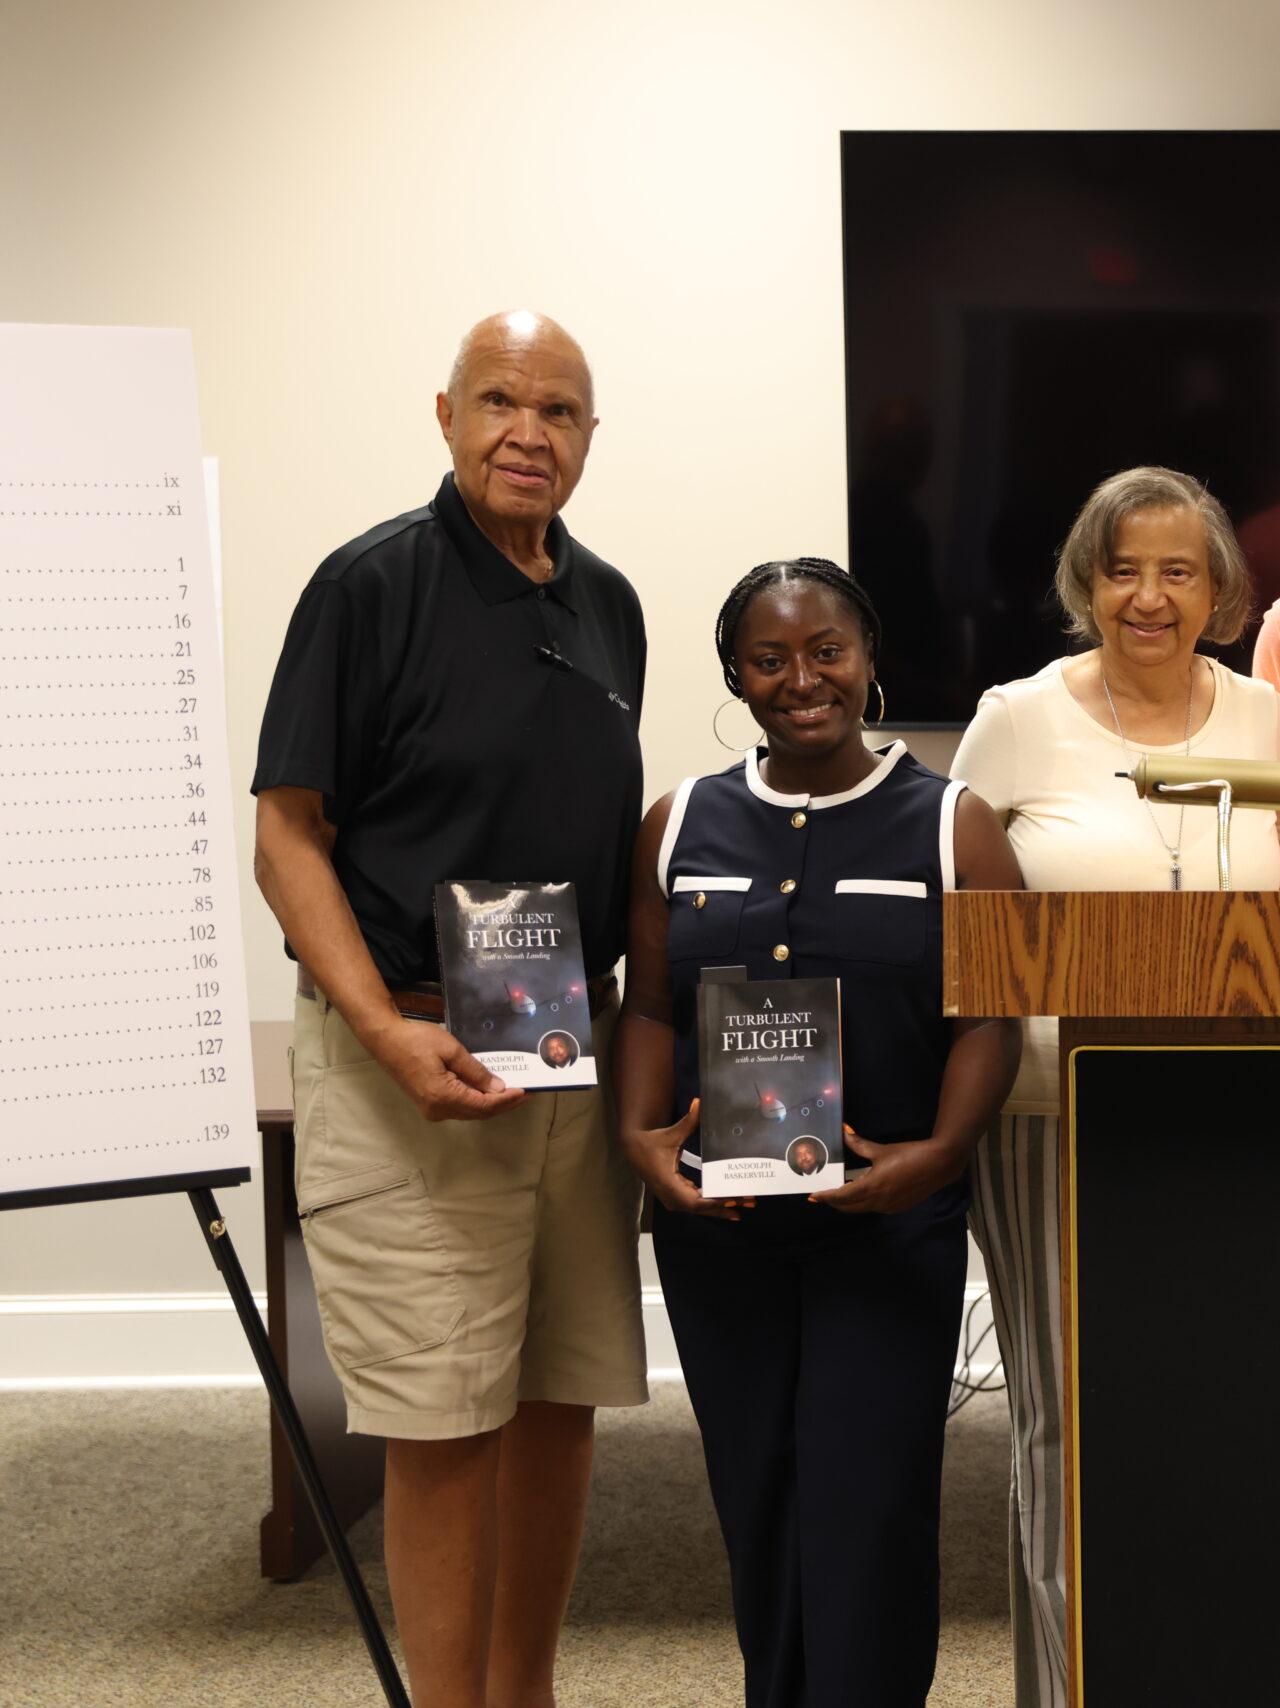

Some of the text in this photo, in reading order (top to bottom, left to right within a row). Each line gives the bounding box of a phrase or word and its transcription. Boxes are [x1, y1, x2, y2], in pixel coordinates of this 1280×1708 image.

[164, 473, 180, 488] ix
[166, 501, 182, 516] xi
[178, 557, 185, 572] 1
[178, 585, 188, 600] 7
[174, 614, 191, 629] 16
[174, 642, 191, 657] 21
[177, 670, 195, 685] 25
[179, 698, 197, 713] 27
[183, 726, 199, 741] 31
[184, 754, 202, 769] 34
[186, 783, 205, 798] 36
[188, 811, 207, 826] 44
[191, 840, 208, 855] 47
[193, 868, 211, 883] 78
[195, 896, 213, 912] 85
[469, 912, 555, 926] TURBULENT
[189, 924, 216, 941] 102
[466, 928, 561, 949] FLIGHT
[192, 954, 218, 969] 106
[503, 952, 525, 960] Smooth
[526, 951, 551, 961] Landing
[195, 982, 220, 998] 119
[763, 998, 773, 1009] A
[195, 1010, 222, 1026] 122
[725, 1012, 812, 1027] TURBULENT
[721, 1028, 818, 1051] FLIGHT
[197, 1039, 223, 1056] 127
[480, 1055, 525, 1064] RANDOLPH
[735, 1055, 749, 1064] with
[756, 1055, 779, 1063] Smooth
[780, 1053, 805, 1062] Landing
[200, 1067, 226, 1084] 132
[203, 1124, 230, 1141] 139
[727, 1161, 772, 1171] RANDOLPH
[723, 1169, 776, 1181] BASKERVILLE
